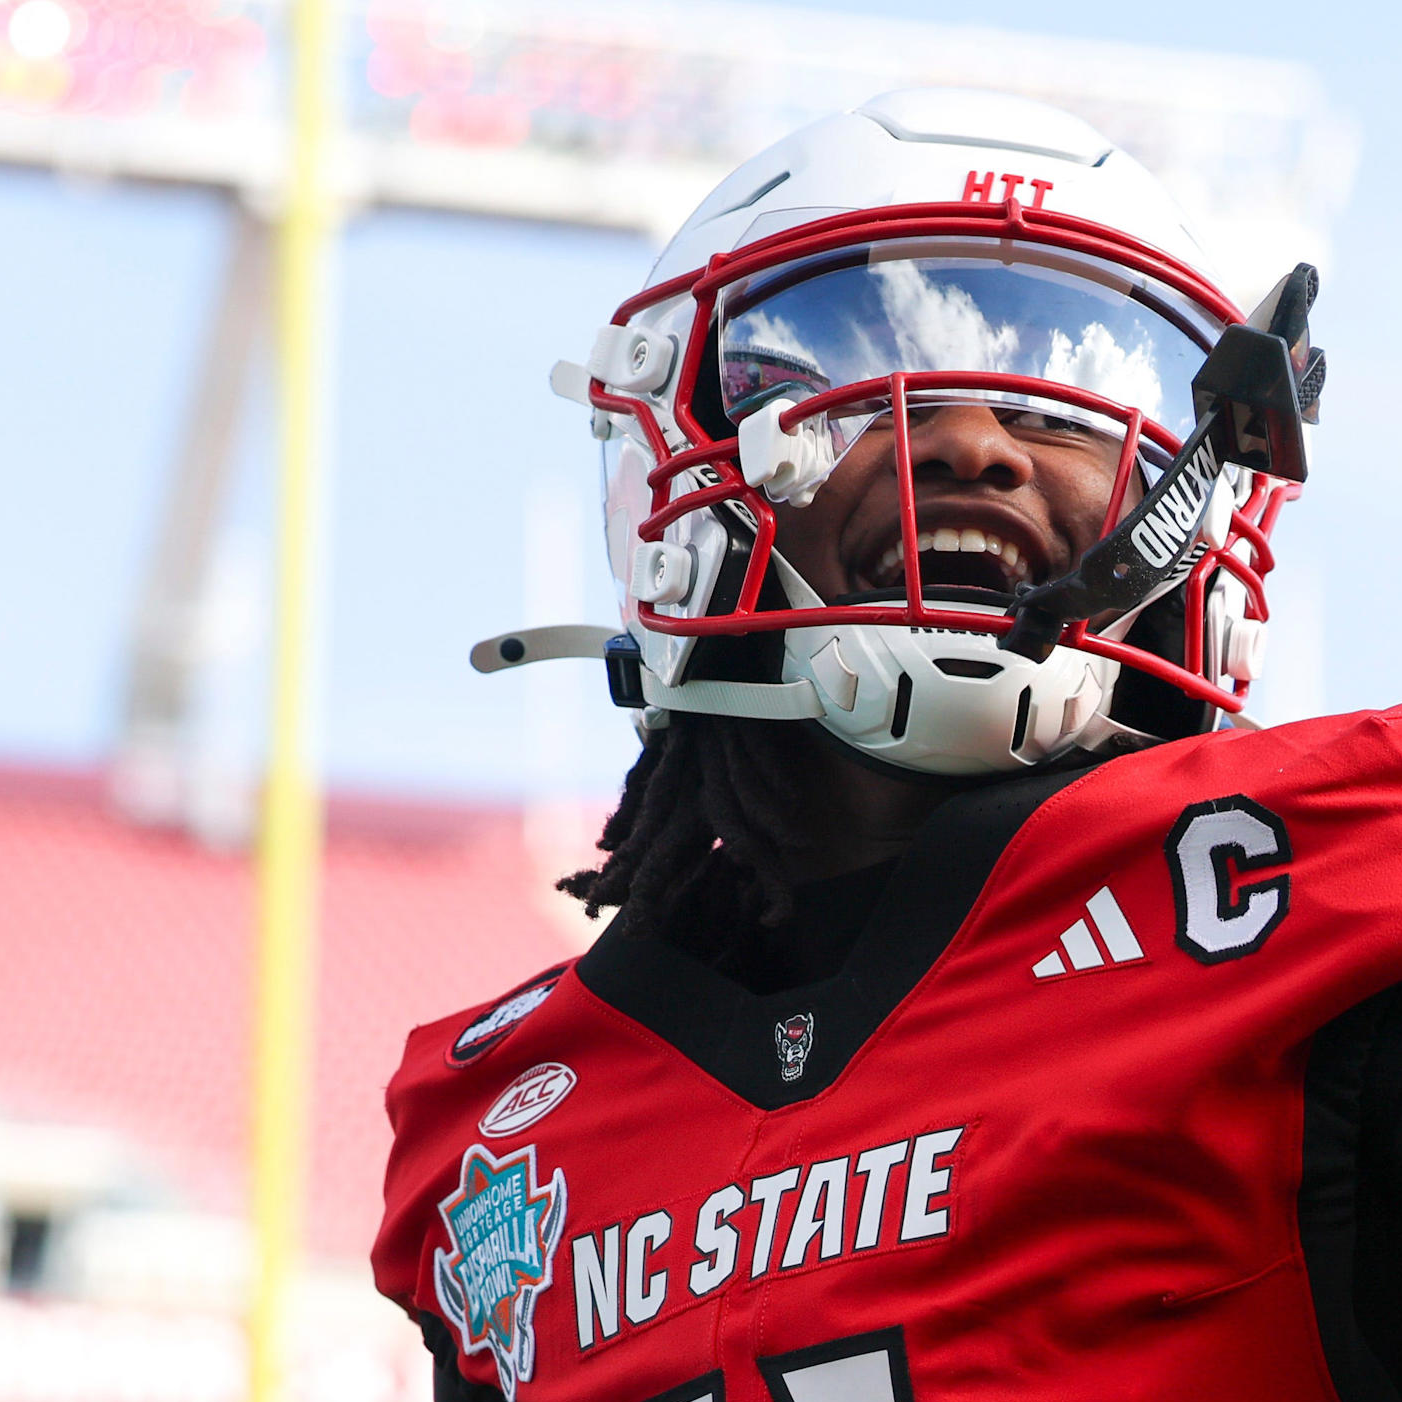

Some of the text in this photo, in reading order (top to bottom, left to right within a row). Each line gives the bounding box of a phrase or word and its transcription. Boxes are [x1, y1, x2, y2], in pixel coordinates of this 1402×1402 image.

[961, 169, 1054, 210] HTT
[1130, 433, 1219, 569] NXTRND
[1165, 793, 1291, 965] C
[492, 1070, 564, 1121] ACC
[571, 1125, 965, 1350] NC STATE
